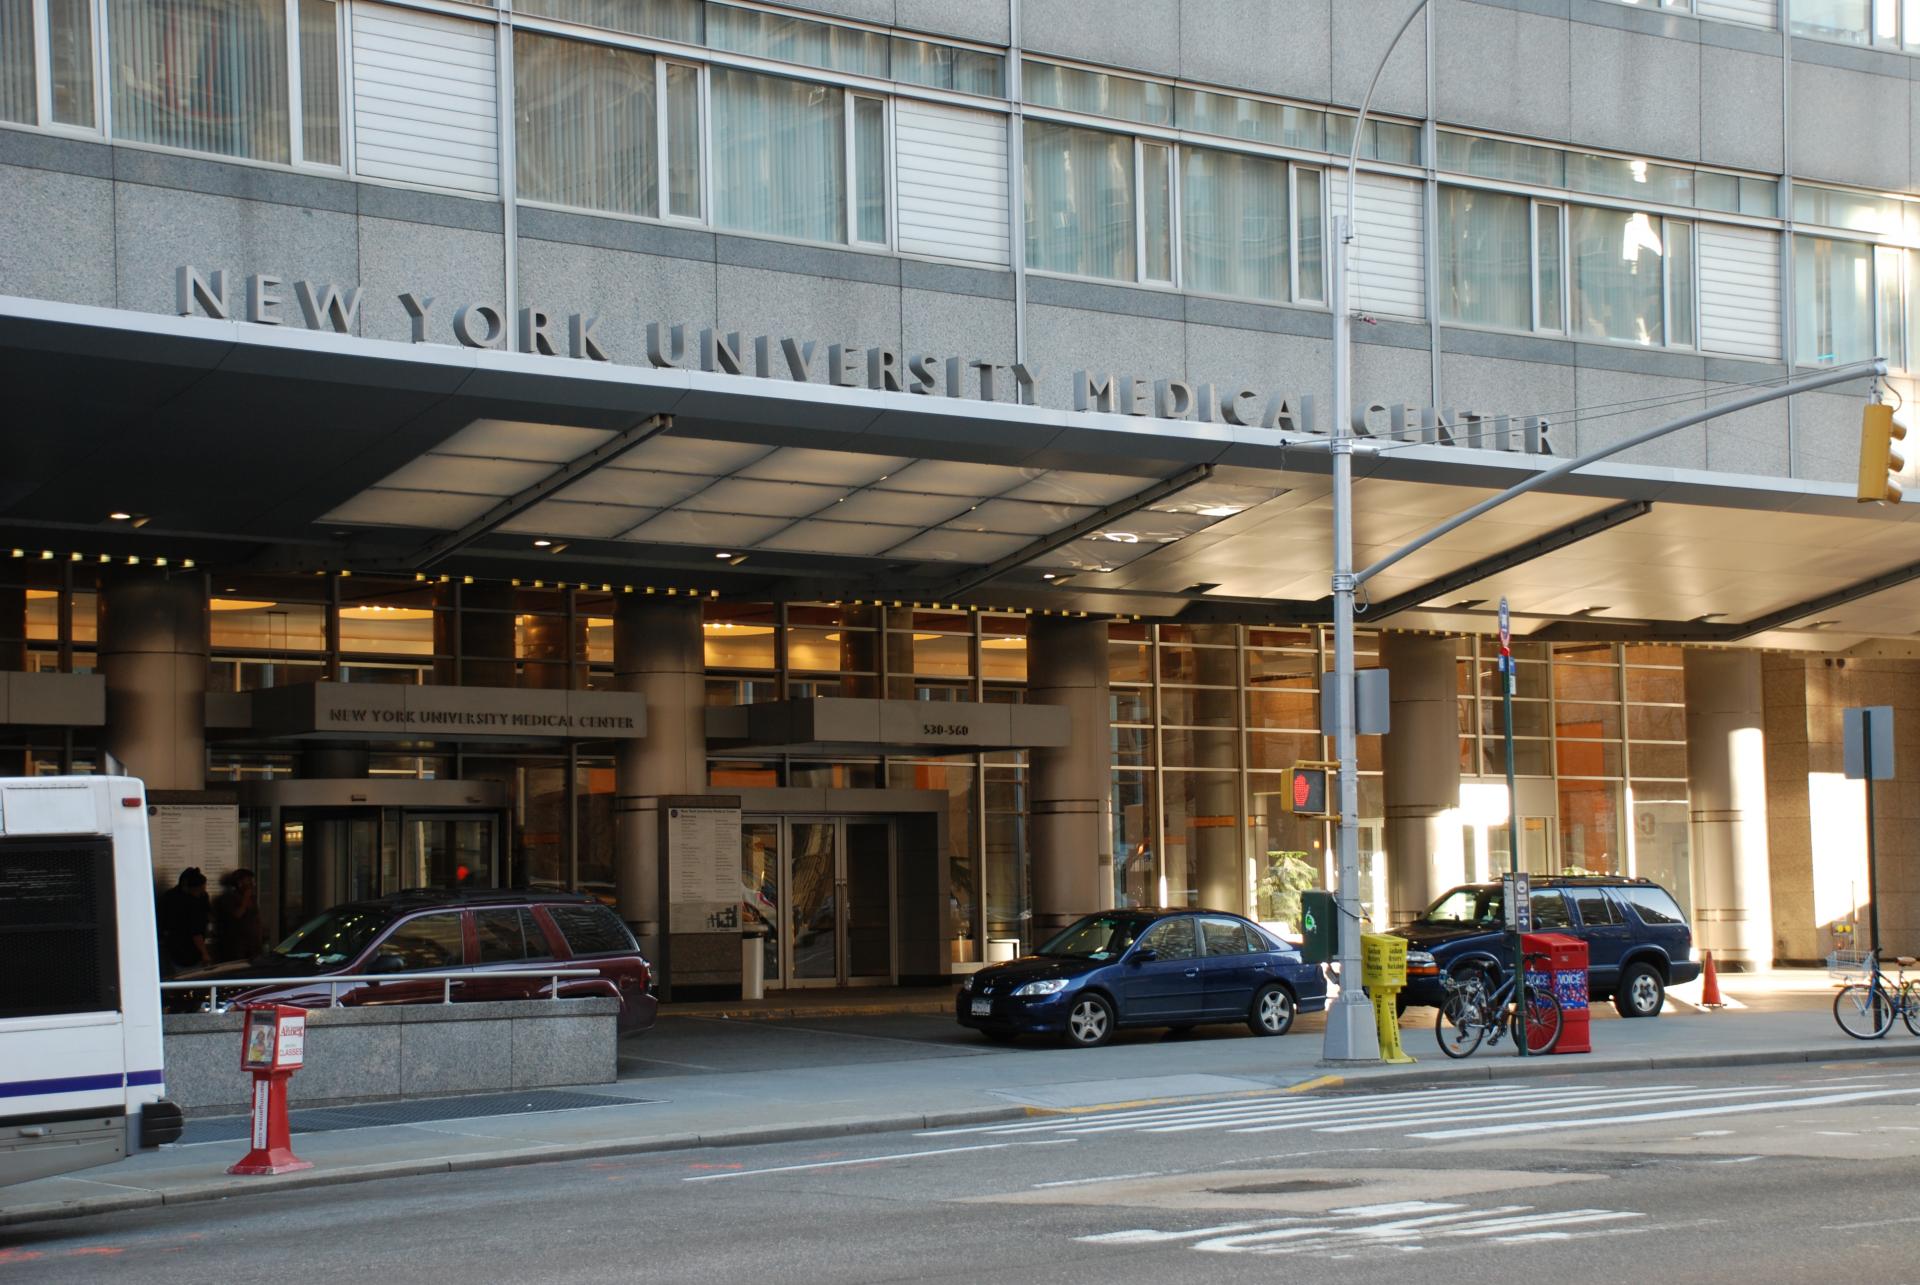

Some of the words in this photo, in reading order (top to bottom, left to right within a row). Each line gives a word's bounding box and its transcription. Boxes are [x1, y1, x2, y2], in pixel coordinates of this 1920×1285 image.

[175, 264, 363, 334] NEW
[398, 292, 608, 361] YORK
[646, 321, 1044, 405] UNIVERSITY
[1073, 368, 1327, 434] MEDICAL
[1351, 401, 1554, 455] CENTER
[329, 708, 367, 722] NEW
[372, 709, 416, 723] YORK
[420, 711, 508, 726] UNIVERSITY
[511, 713, 575, 728] MEDICAL
[579, 716, 634, 729] CENTER
[923, 723, 969, 736] 530-560
[1557, 973, 1582, 986] VOICE
[280, 1048, 304, 1057] CLASSES
